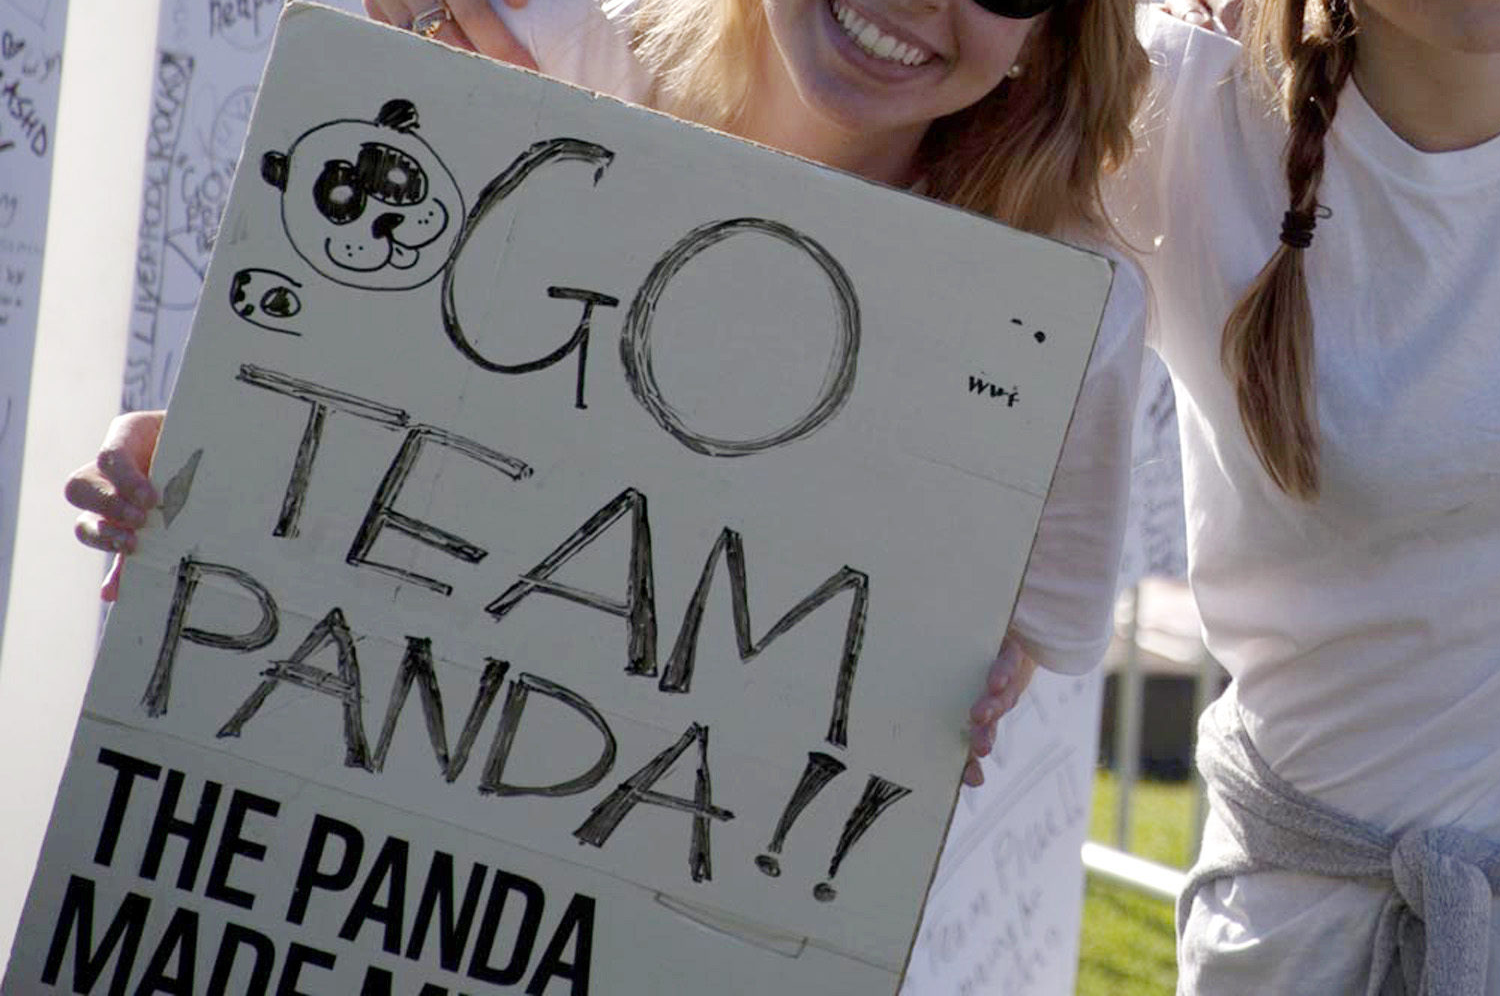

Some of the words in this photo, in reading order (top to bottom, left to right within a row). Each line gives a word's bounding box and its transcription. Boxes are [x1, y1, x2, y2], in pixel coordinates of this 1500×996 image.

[440, 136, 862, 457] GO
[235, 363, 870, 750] TEAM
[92, 747, 281, 910] THE
[286, 813, 598, 996] PANDA
[142, 555, 912, 904] PANDA!!
